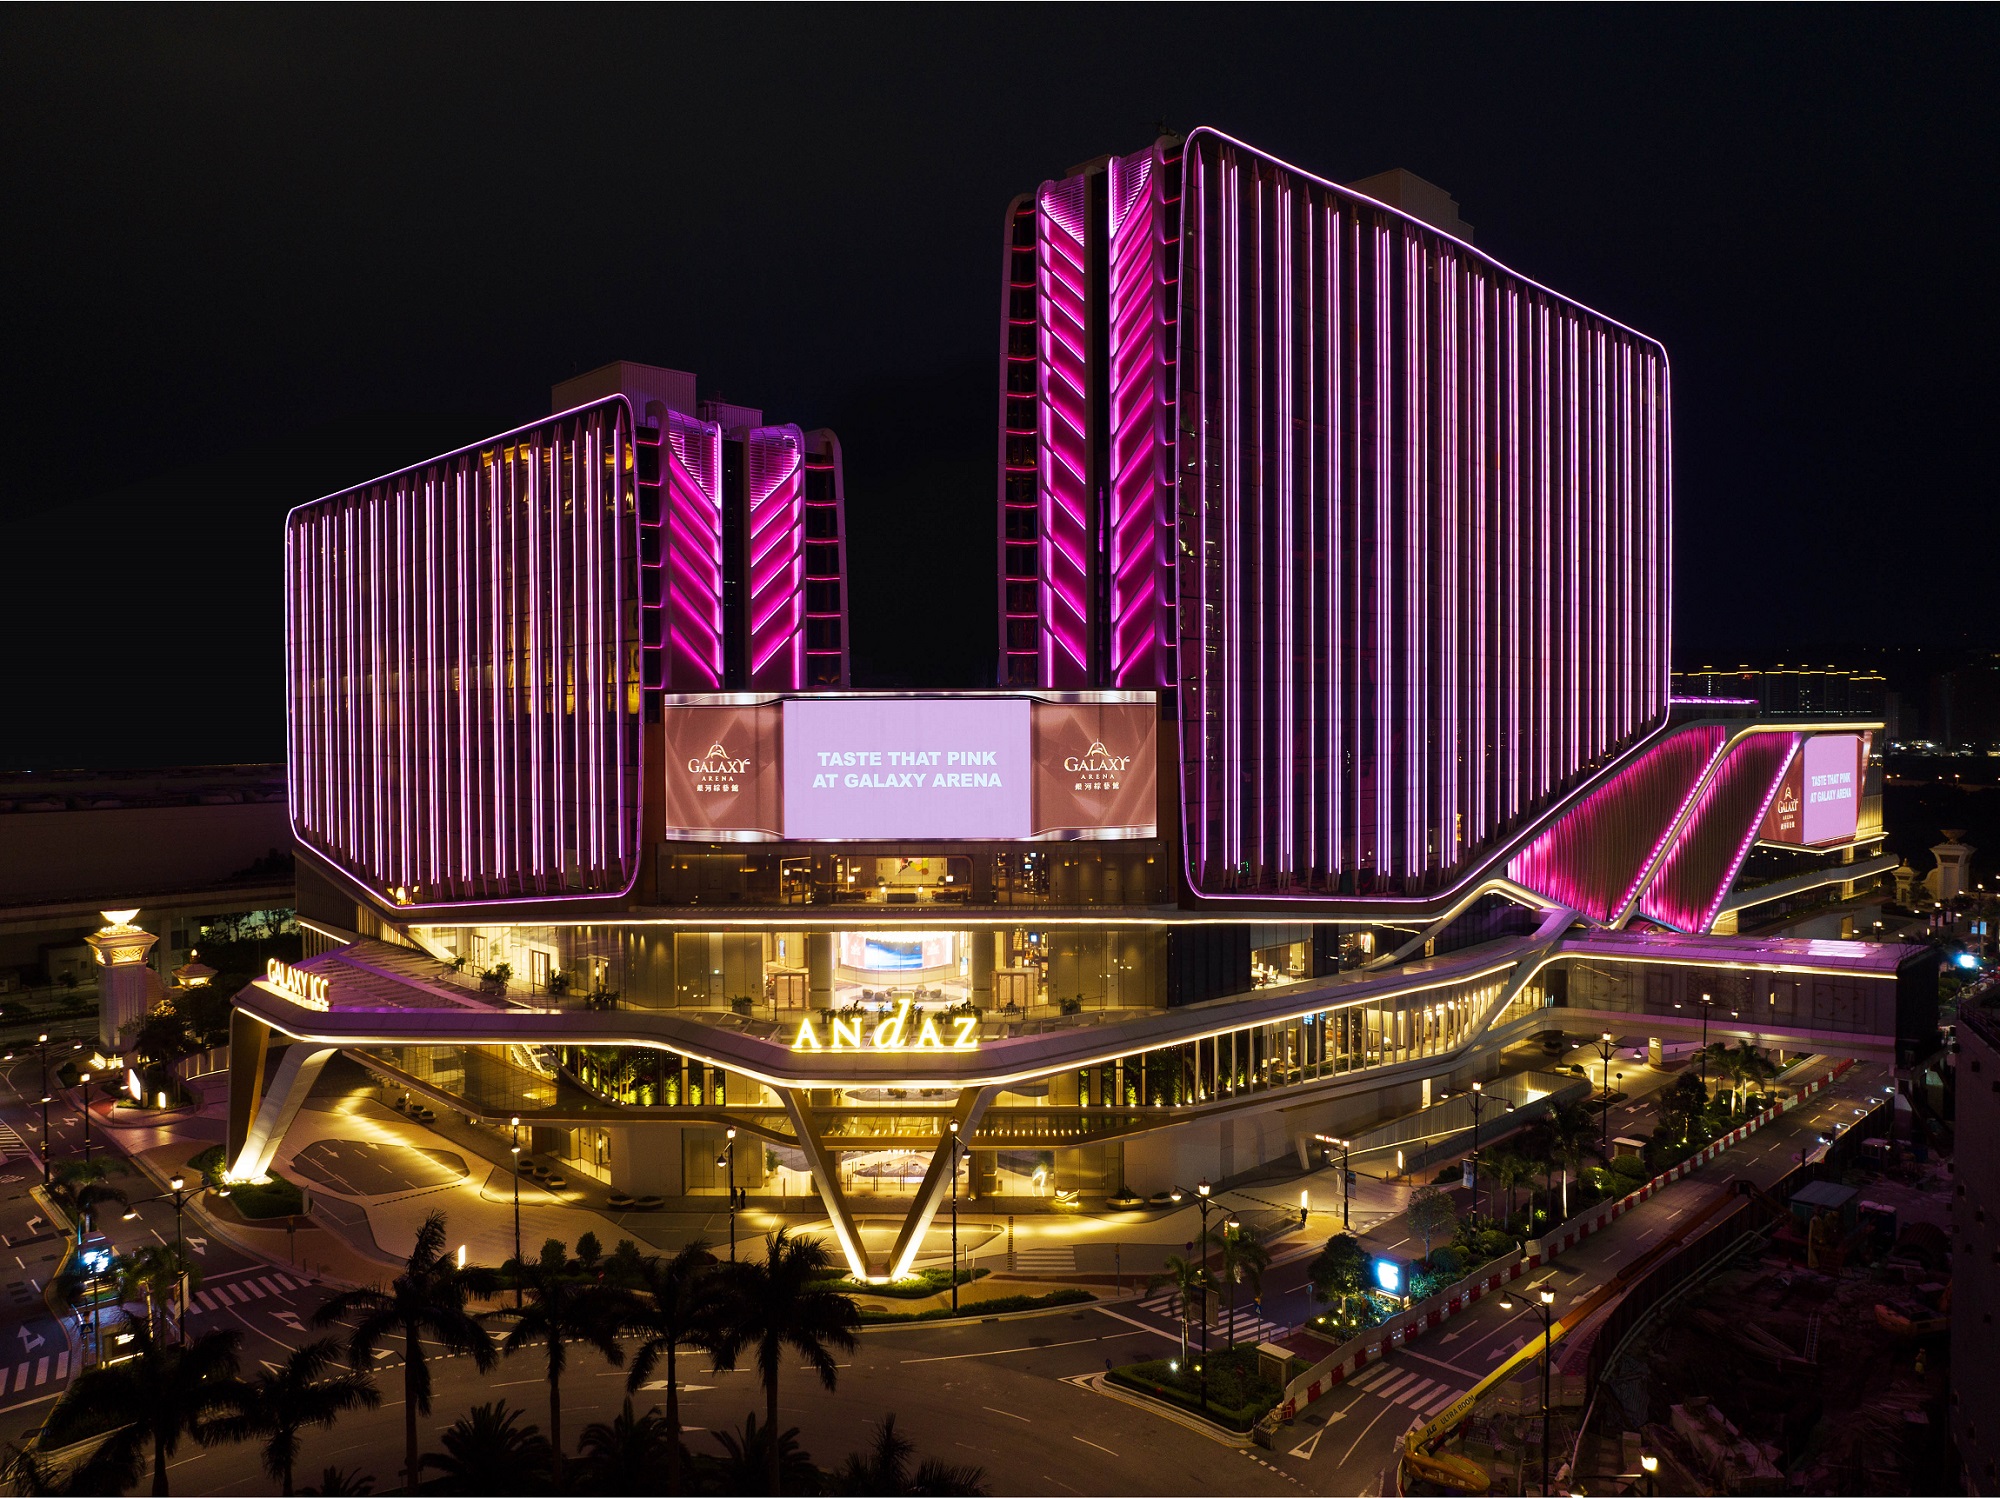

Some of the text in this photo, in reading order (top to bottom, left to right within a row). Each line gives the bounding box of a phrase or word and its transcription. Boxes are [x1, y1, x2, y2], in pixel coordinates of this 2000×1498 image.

[688, 758, 751, 773] GALAXY
[817, 751, 997, 767] TASTE THAT PINK
[1064, 756, 1131, 772] GALAXY
[812, 773, 1002, 788] AT GALAXY ARENA
[1812, 773, 1851, 786] TASTE THAT PINK
[1810, 788, 1851, 803] AT GALAXY ARENA
[1778, 798, 1799, 813] GALAXY
[267, 957, 329, 1007] GALAXY ICC
[1426, 1394, 1476, 1437] JLG ULTRA BOOM
